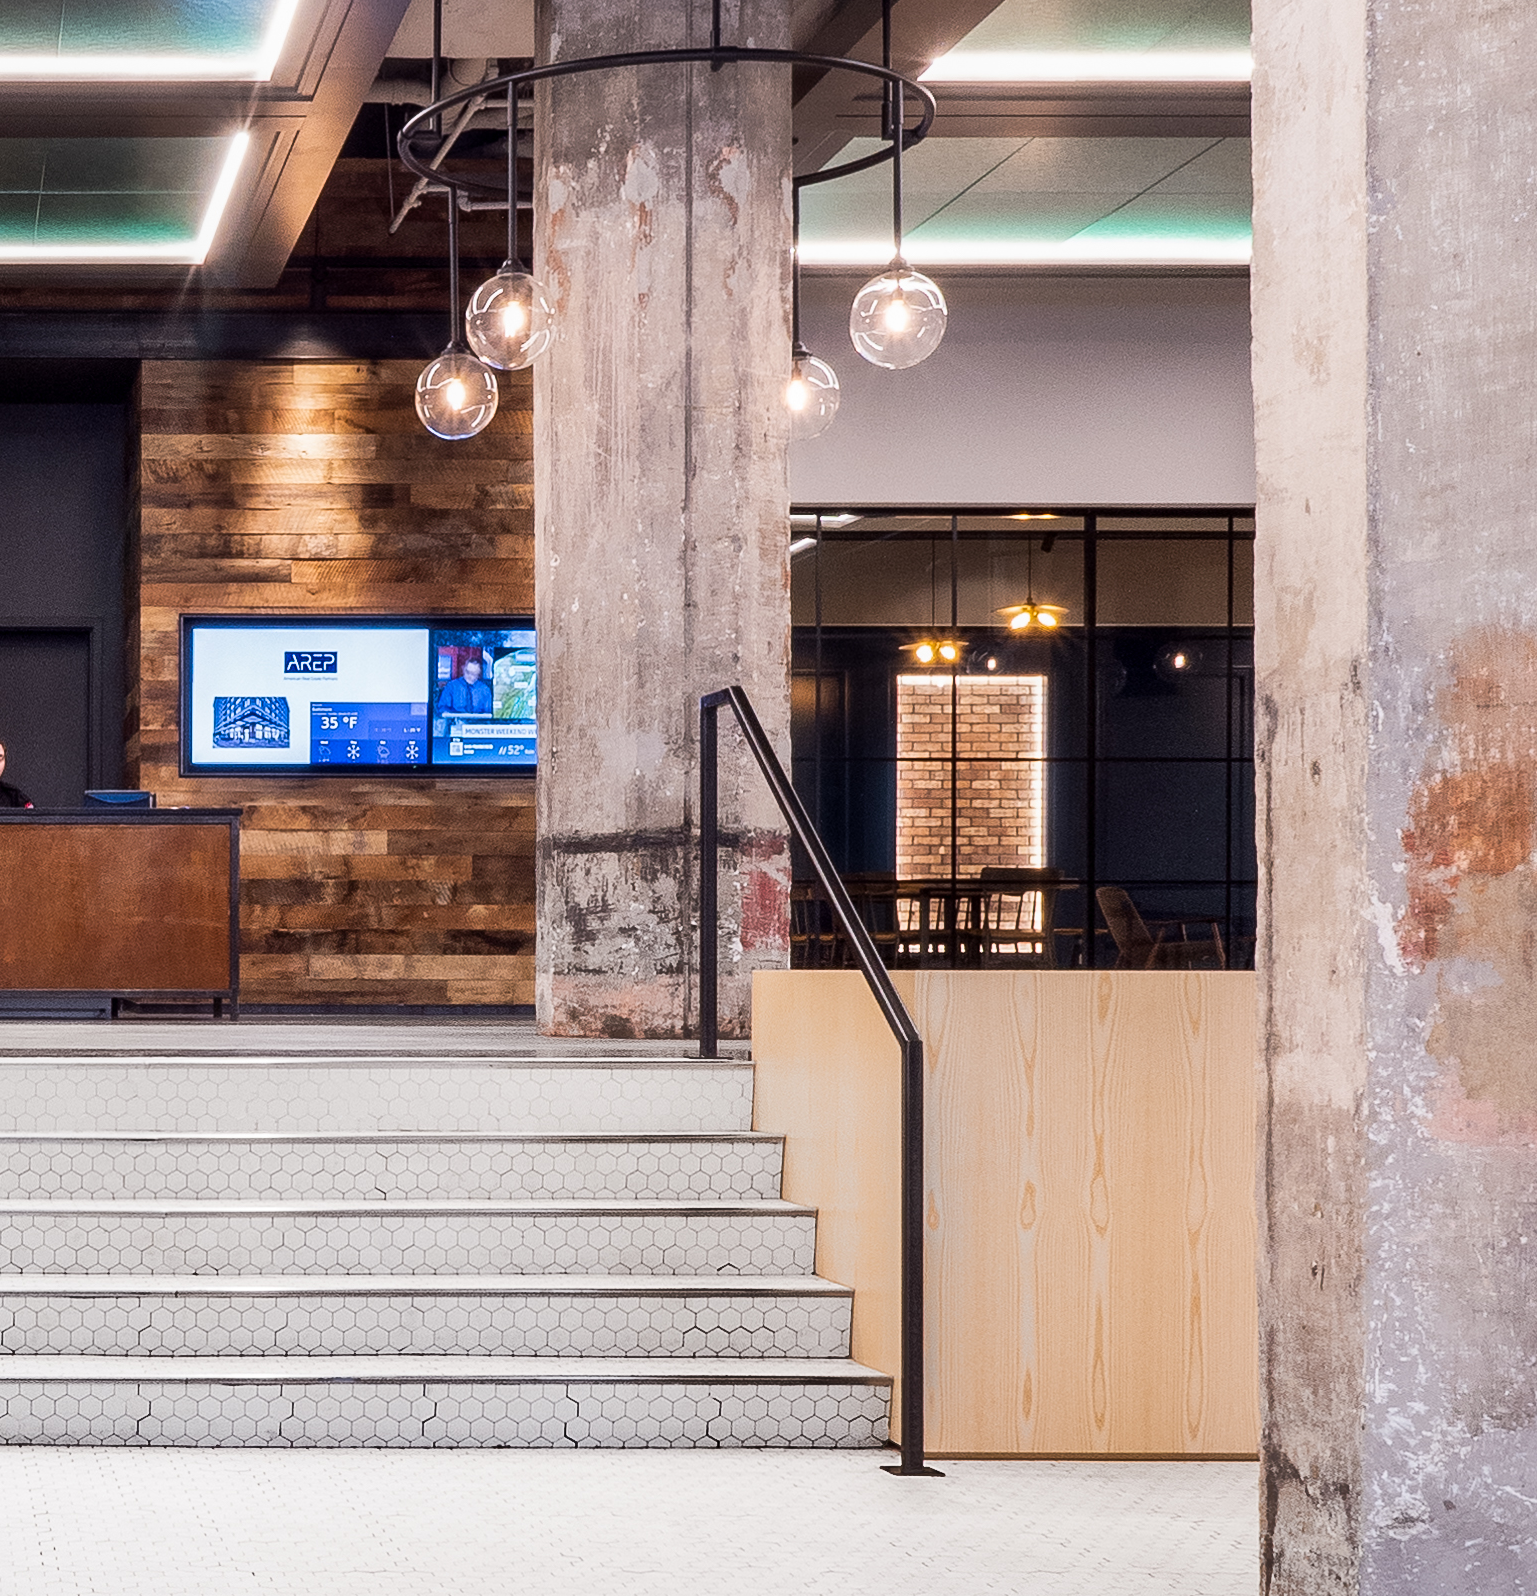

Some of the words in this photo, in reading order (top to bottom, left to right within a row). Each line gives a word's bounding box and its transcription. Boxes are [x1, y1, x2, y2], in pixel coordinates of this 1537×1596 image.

[287, 654, 335, 671] AREP
[321, 716, 338, 729] 35
[342, 716, 358, 729] °F
